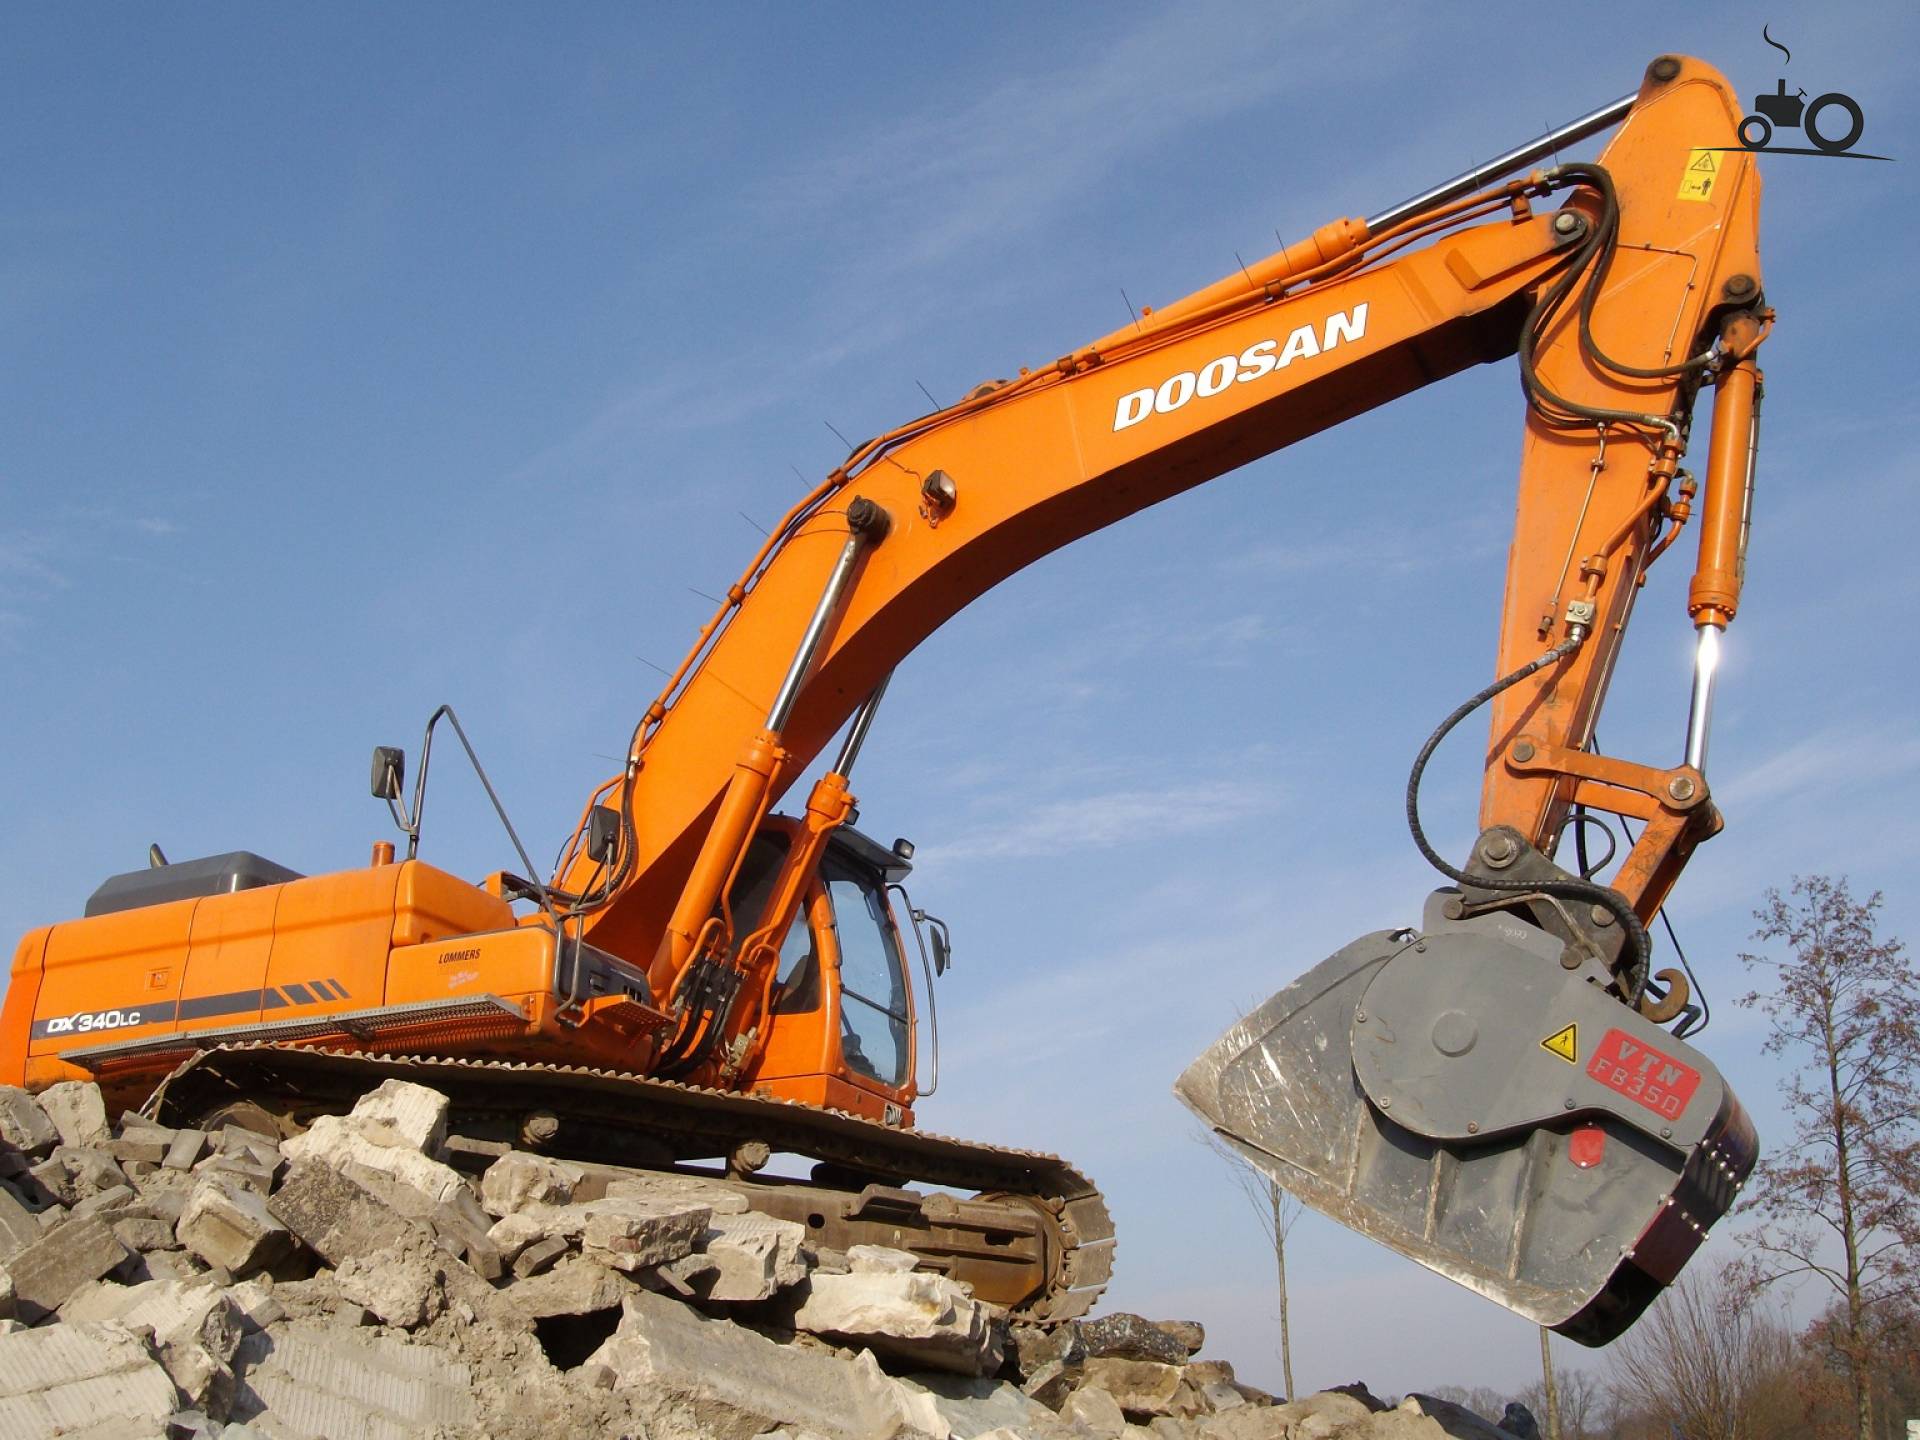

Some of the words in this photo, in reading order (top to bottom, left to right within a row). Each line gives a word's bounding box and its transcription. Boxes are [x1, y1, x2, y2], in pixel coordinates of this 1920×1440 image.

[1113, 301, 1369, 432] DOOSAN
[438, 948, 481, 964] LOMMERS
[1593, 1057, 1681, 1114] FB350
[1618, 1039, 1684, 1087] VTN
